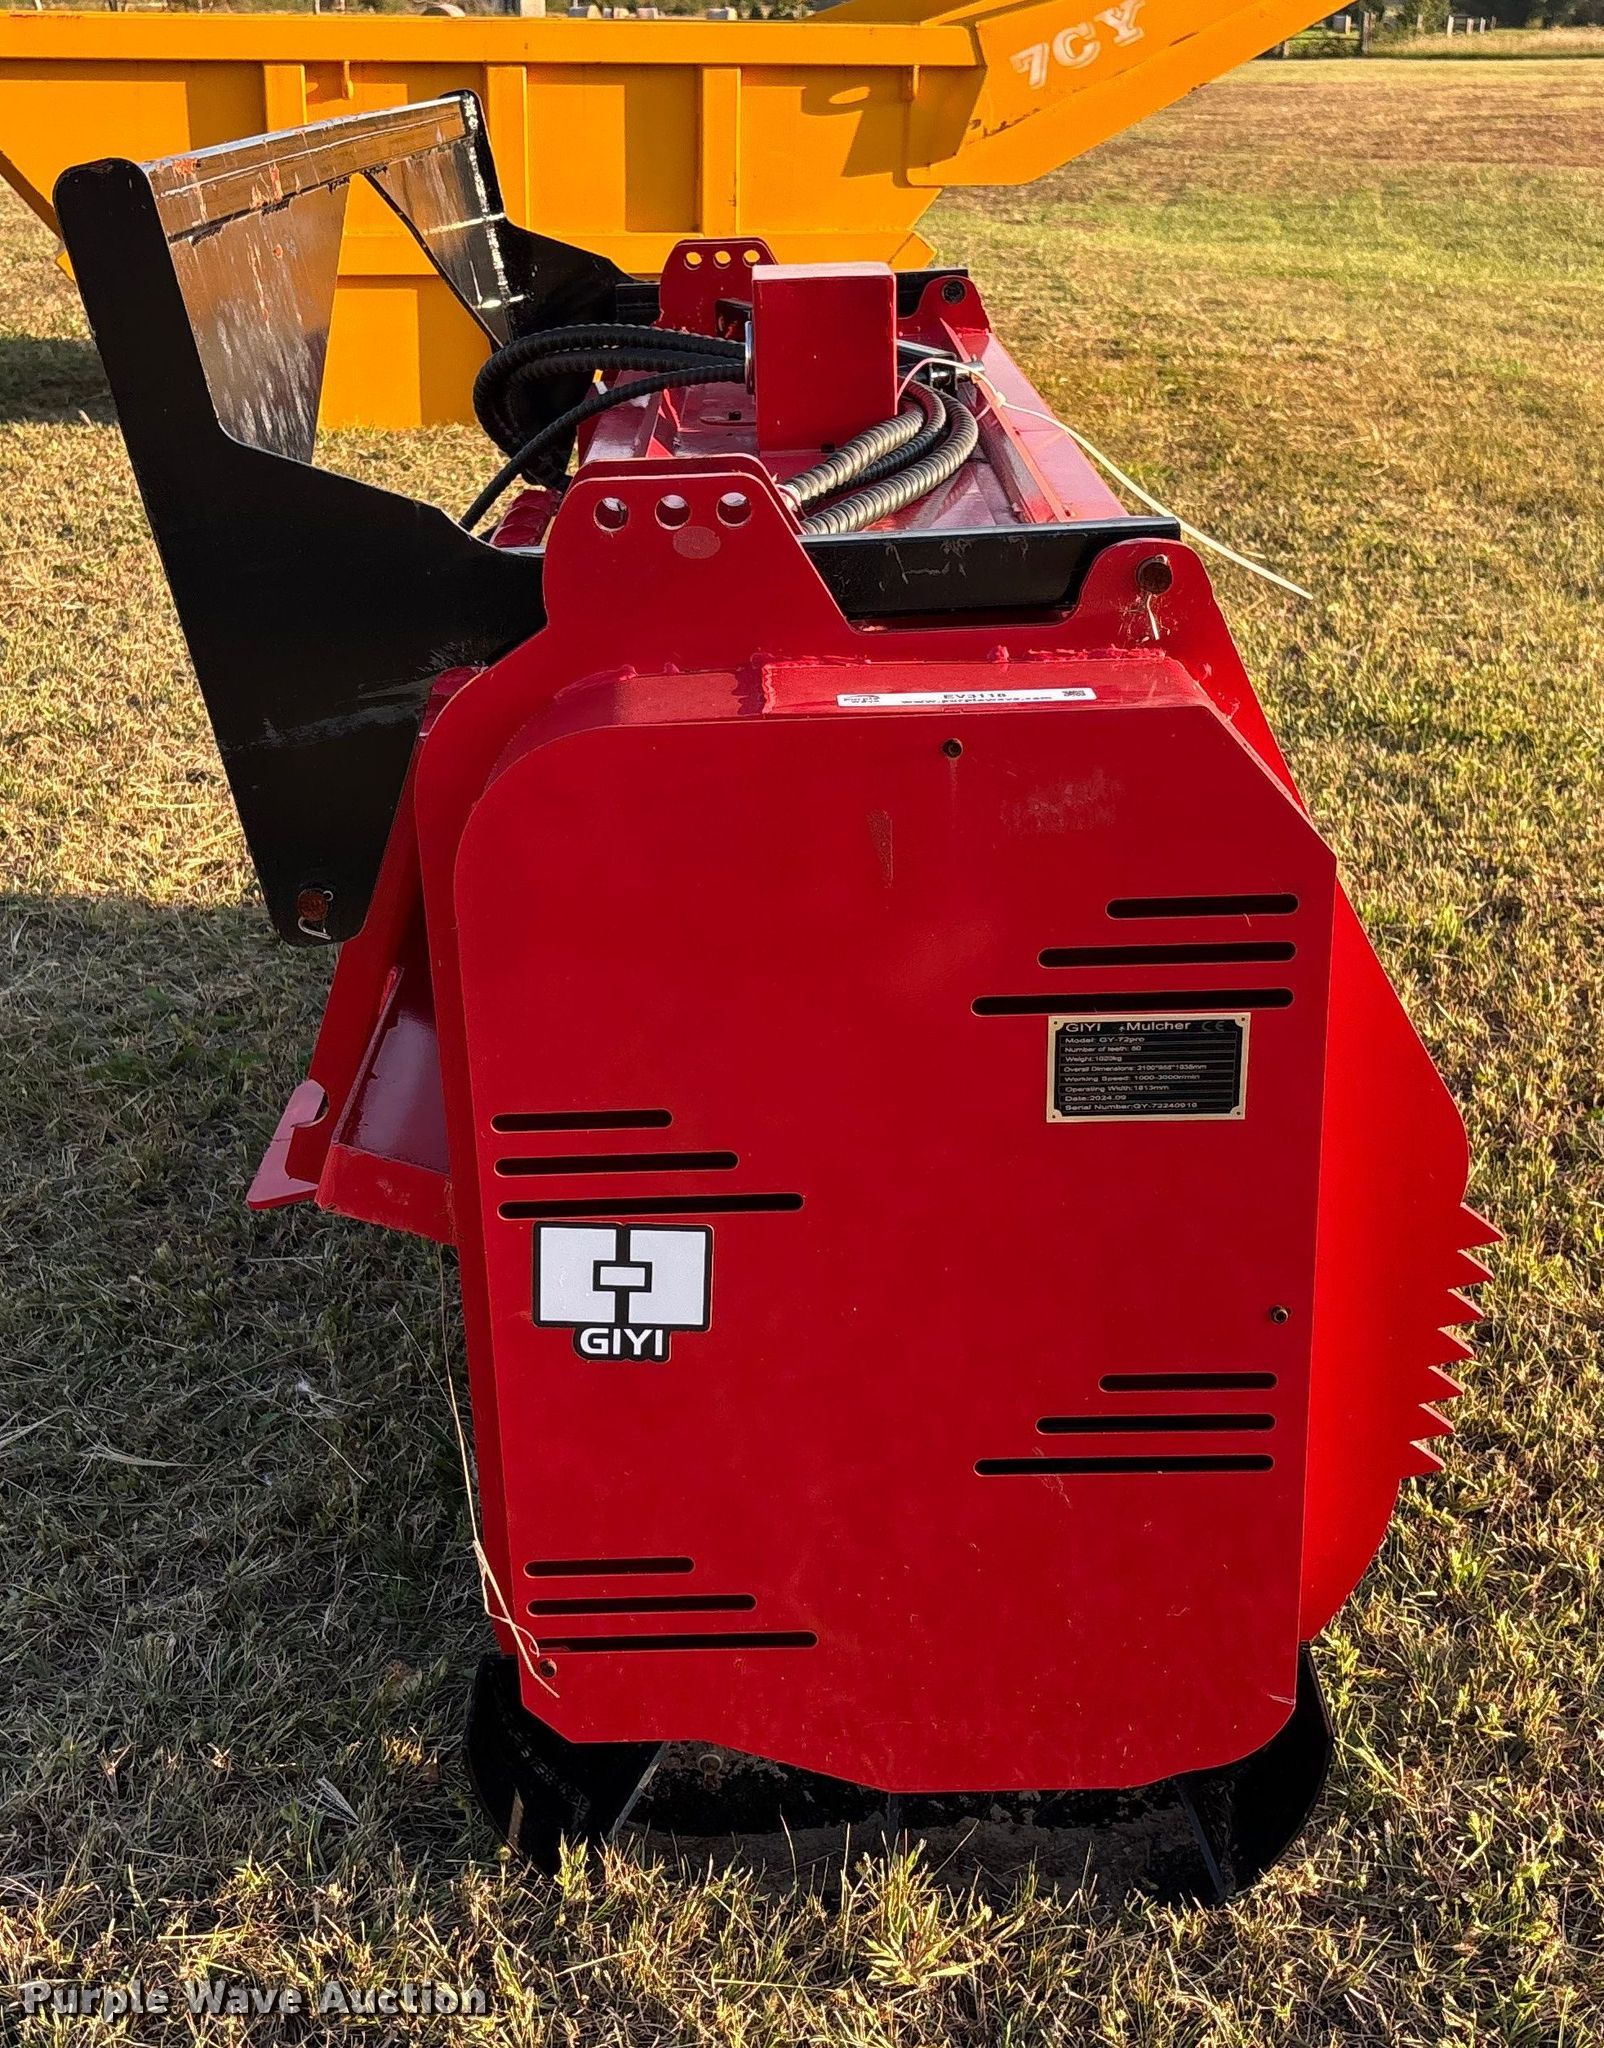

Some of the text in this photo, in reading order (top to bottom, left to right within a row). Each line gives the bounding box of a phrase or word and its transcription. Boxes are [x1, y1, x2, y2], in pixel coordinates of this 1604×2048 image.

[1009, 0, 1146, 90] 7CY
[1065, 1023, 1101, 1033] GIYI
[1126, 1021, 1191, 1031] Mulcher
[1099, 1036, 1145, 1044] GY-72pro
[1065, 1075, 1099, 1083] Working
[580, 1327, 663, 1356] GIYI
